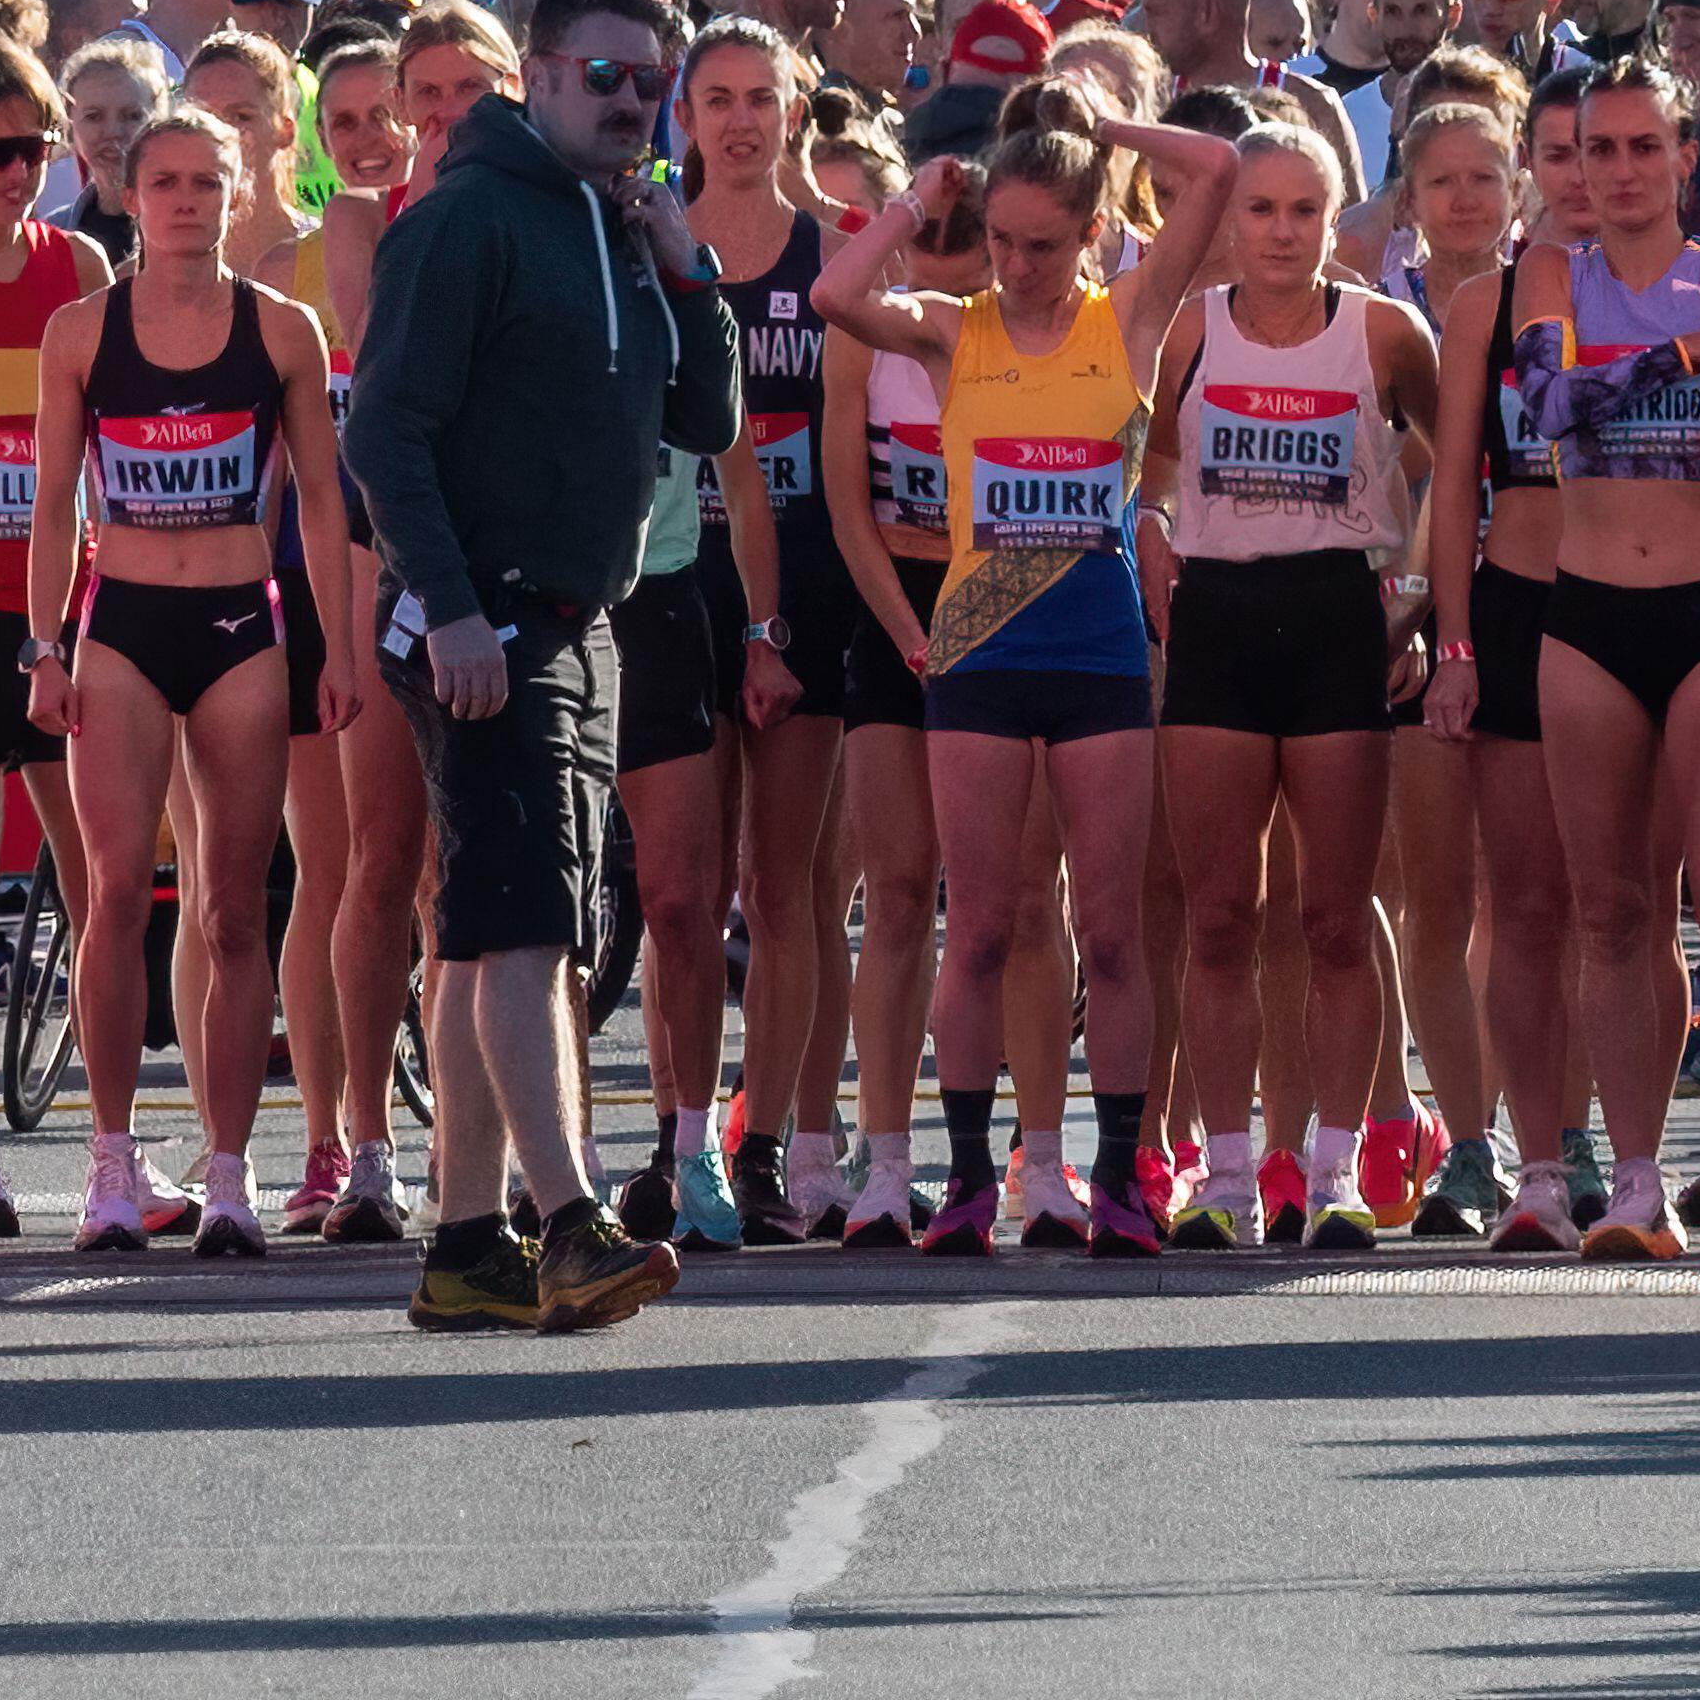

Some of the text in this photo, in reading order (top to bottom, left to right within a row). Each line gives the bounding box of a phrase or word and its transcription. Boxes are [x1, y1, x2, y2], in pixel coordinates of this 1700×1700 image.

[749, 327, 823, 379] NAVY
[1212, 426, 1342, 469] BRIGGS
[115, 455, 242, 493] IRWIN
[986, 479, 1114, 521] QUIRK
